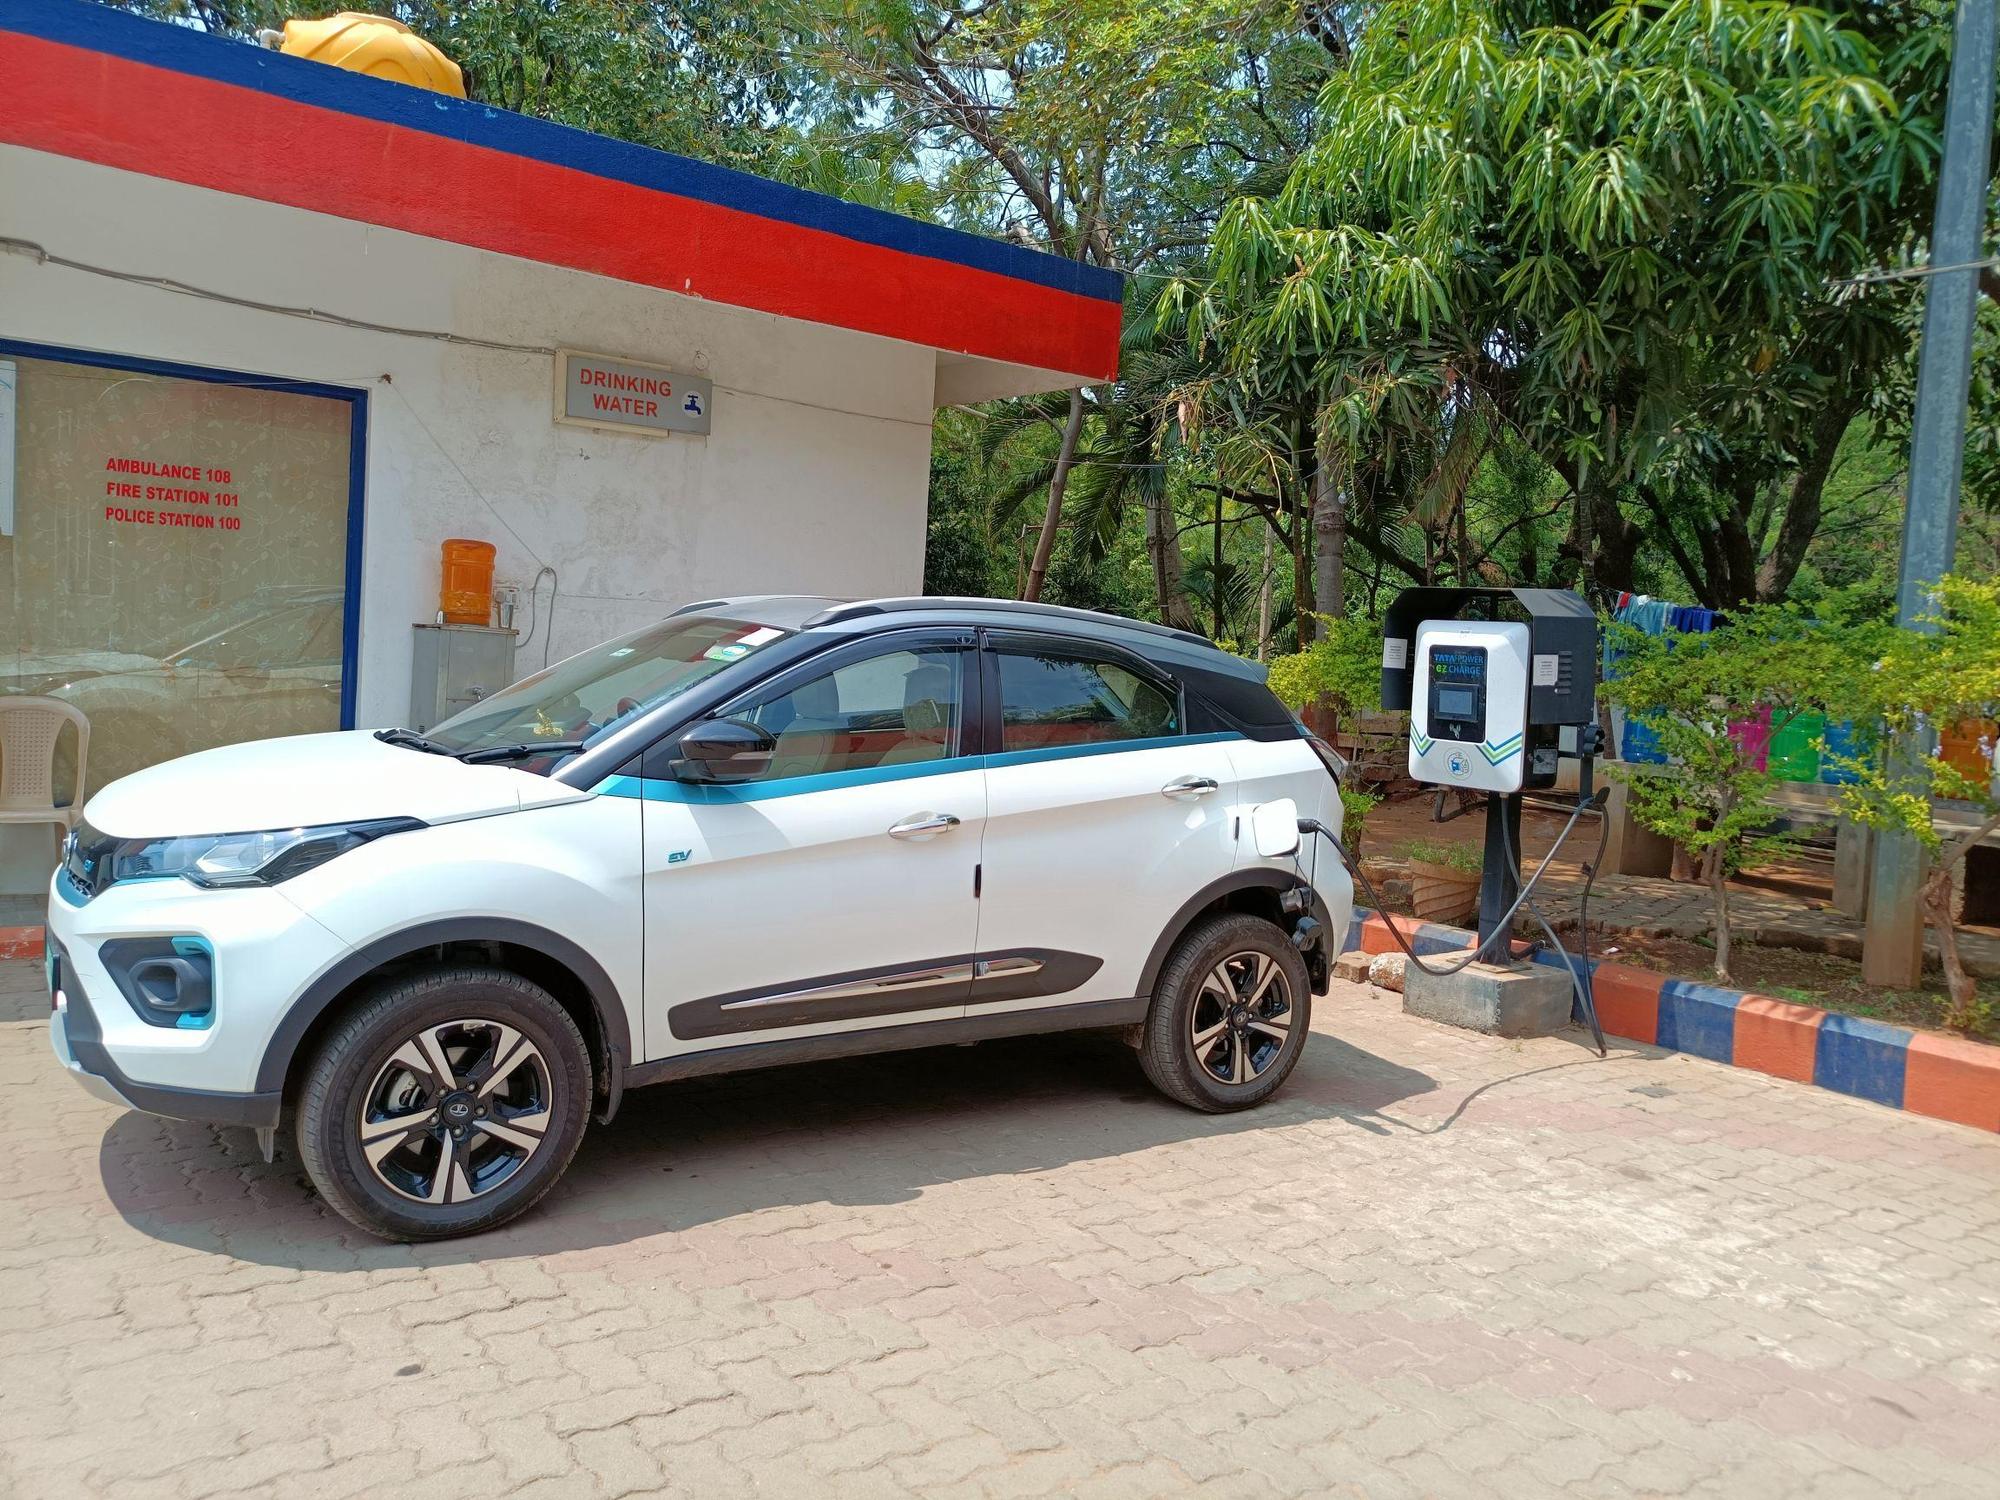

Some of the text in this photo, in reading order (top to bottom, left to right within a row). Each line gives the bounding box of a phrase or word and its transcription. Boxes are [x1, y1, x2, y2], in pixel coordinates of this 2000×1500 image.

[580, 368, 672, 398] DRINKING
[593, 393, 658, 418] WATER
[106, 458, 231, 484] AMBULANCE 108
[106, 482, 238, 507] FIRE STATION 101
[105, 507, 241, 530] POLICE STATION 100
[1434, 654, 1484, 665] TATA POWER
[1448, 665, 1481, 677] CHARGE
[668, 849, 692, 863] EV
